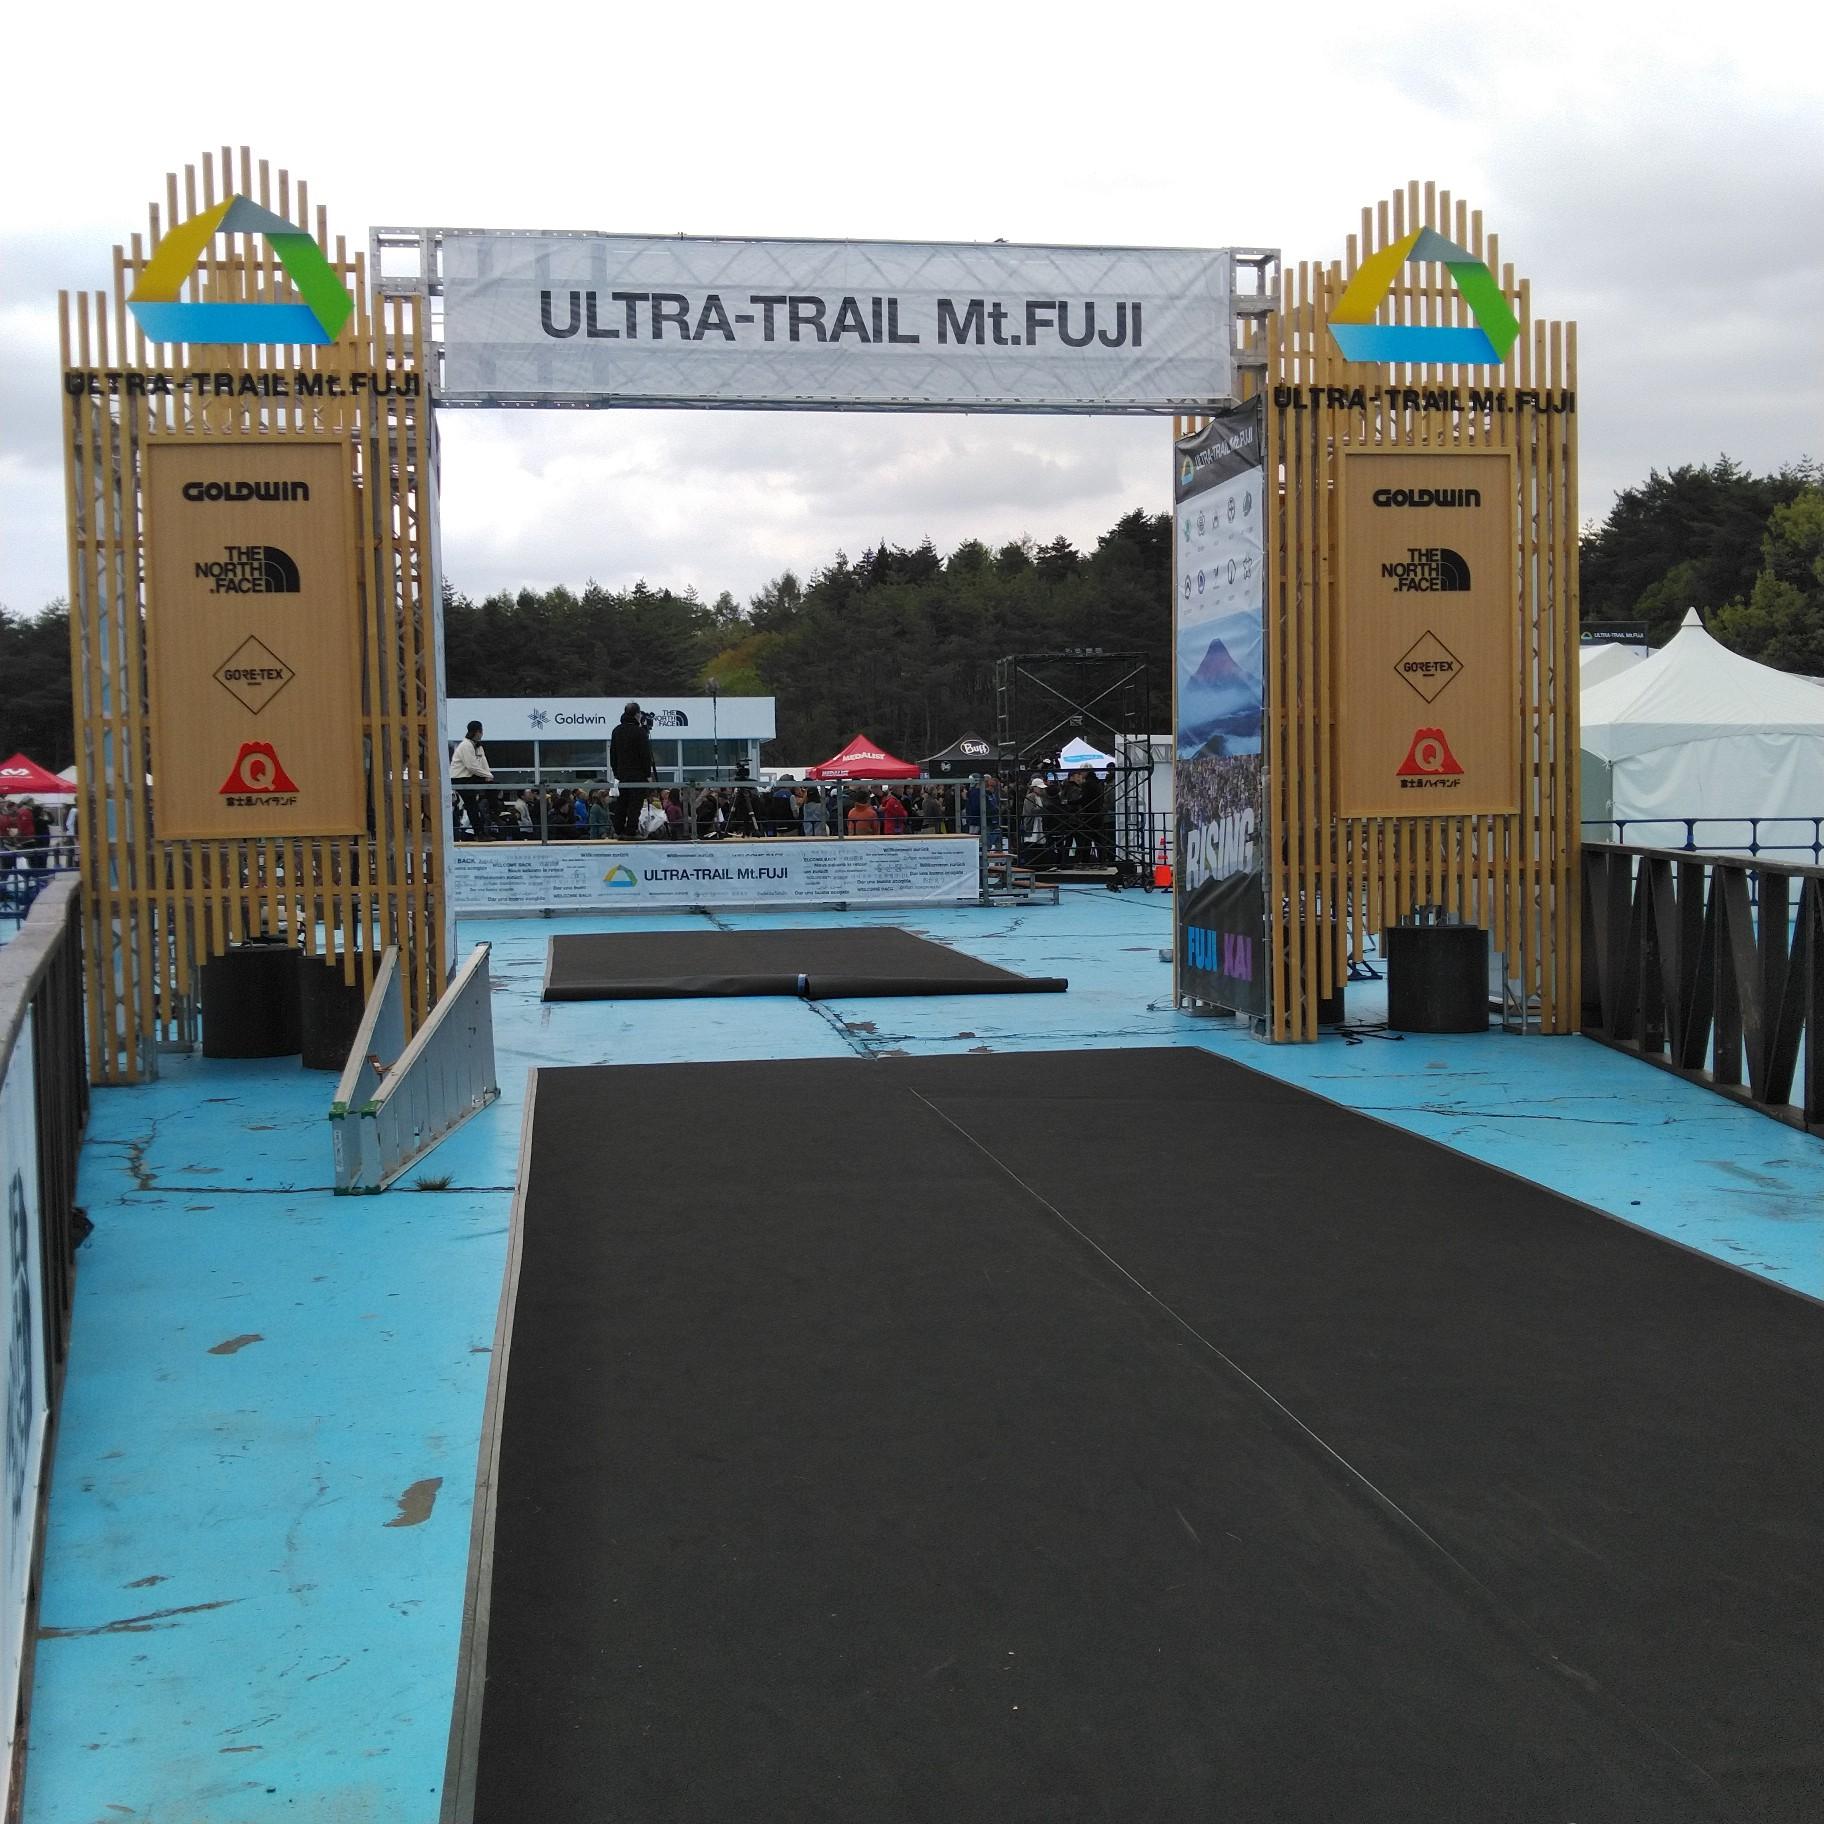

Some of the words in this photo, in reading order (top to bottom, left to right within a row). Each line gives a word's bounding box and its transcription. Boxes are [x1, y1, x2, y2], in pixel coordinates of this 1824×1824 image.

[540, 290, 920, 344] ULTRA-TRAIL
[936, 298, 1142, 347] Mt.FUJI
[65, 372, 290, 397] ULTRA-TRAIL
[298, 372, 421, 397] Mt.FUJI
[1274, 386, 1465, 411] ULTRA-TRAIL
[1472, 389, 1576, 413] Mt.FUJI
[224, 545, 262, 562] THE
[1407, 548, 1440, 563] THE
[195, 562, 264, 578] NORTH
[1381, 562, 1440, 578] NORTH
[224, 668, 284, 681] GORE-TEX
[1403, 661, 1454, 673] GORE-TEX
[554, 713, 606, 725] Goldwin
[842, 752, 886, 762] MEDALIST
[1414, 737, 1445, 773] Q
[240, 752, 277, 791] Q
[1185, 808, 1255, 892] RISING
[644, 868, 734, 881] ULTRA-TRAIL
[737, 867, 788, 880] Mt.FUJI
[1186, 926, 1218, 973] FUJI
